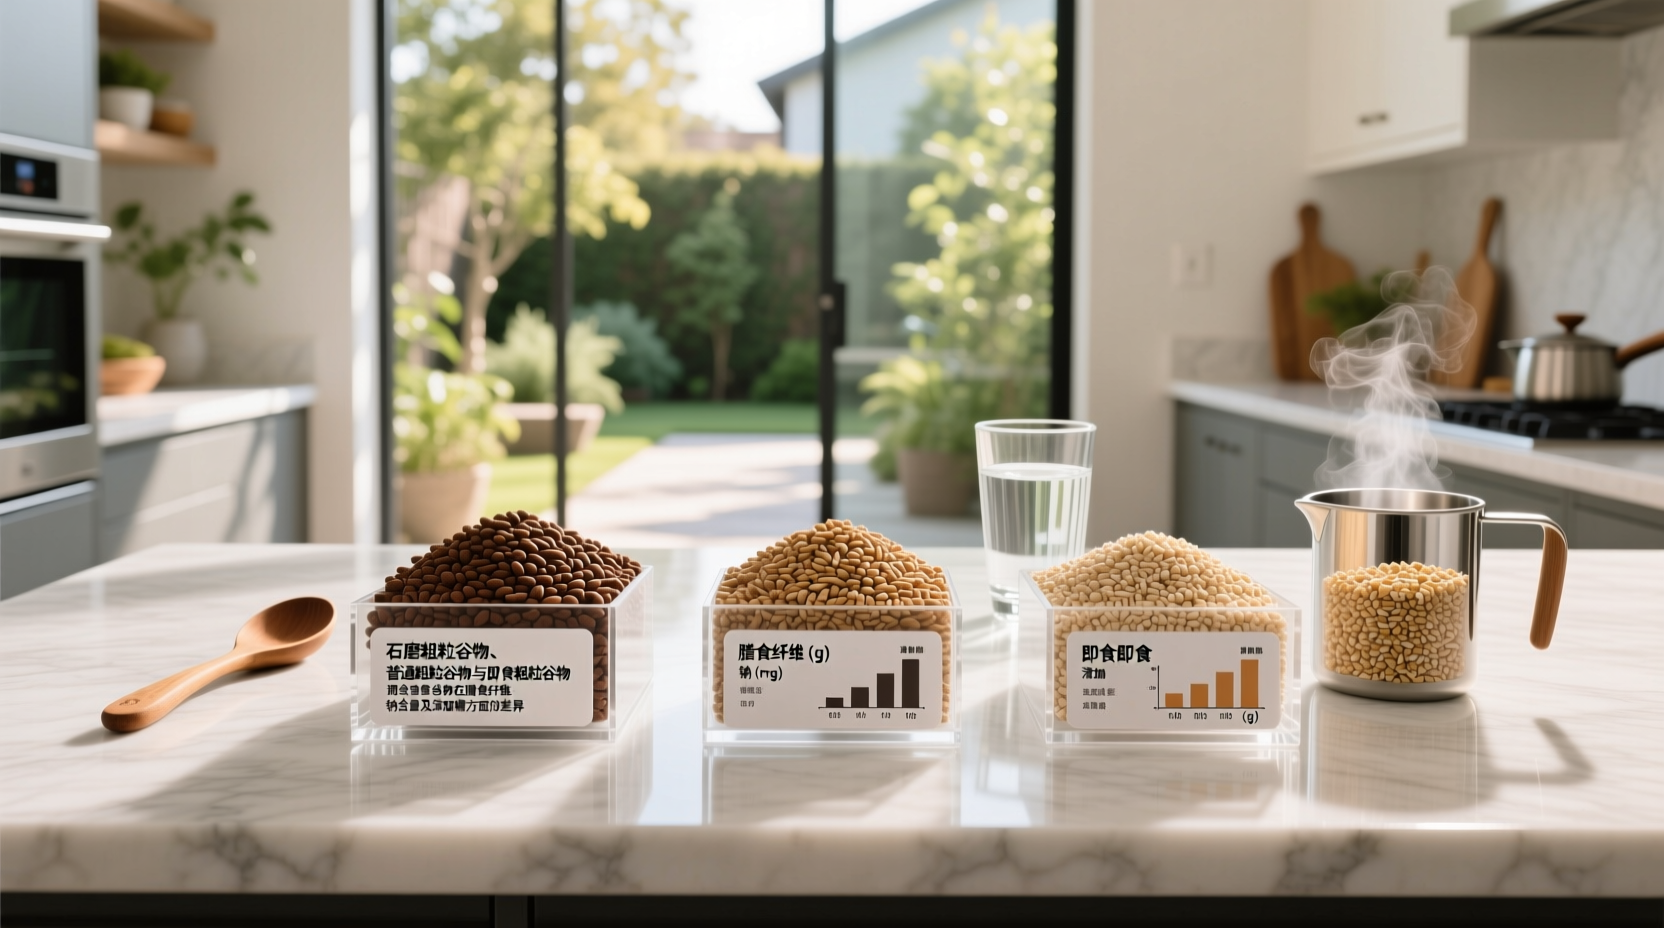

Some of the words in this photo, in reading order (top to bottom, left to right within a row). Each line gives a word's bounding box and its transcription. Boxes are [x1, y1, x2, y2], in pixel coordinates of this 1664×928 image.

[808, 645, 830, 663] (g)
[1081, 643, 1153, 663] 即食即食
[1242, 710, 1259, 725] (g)
